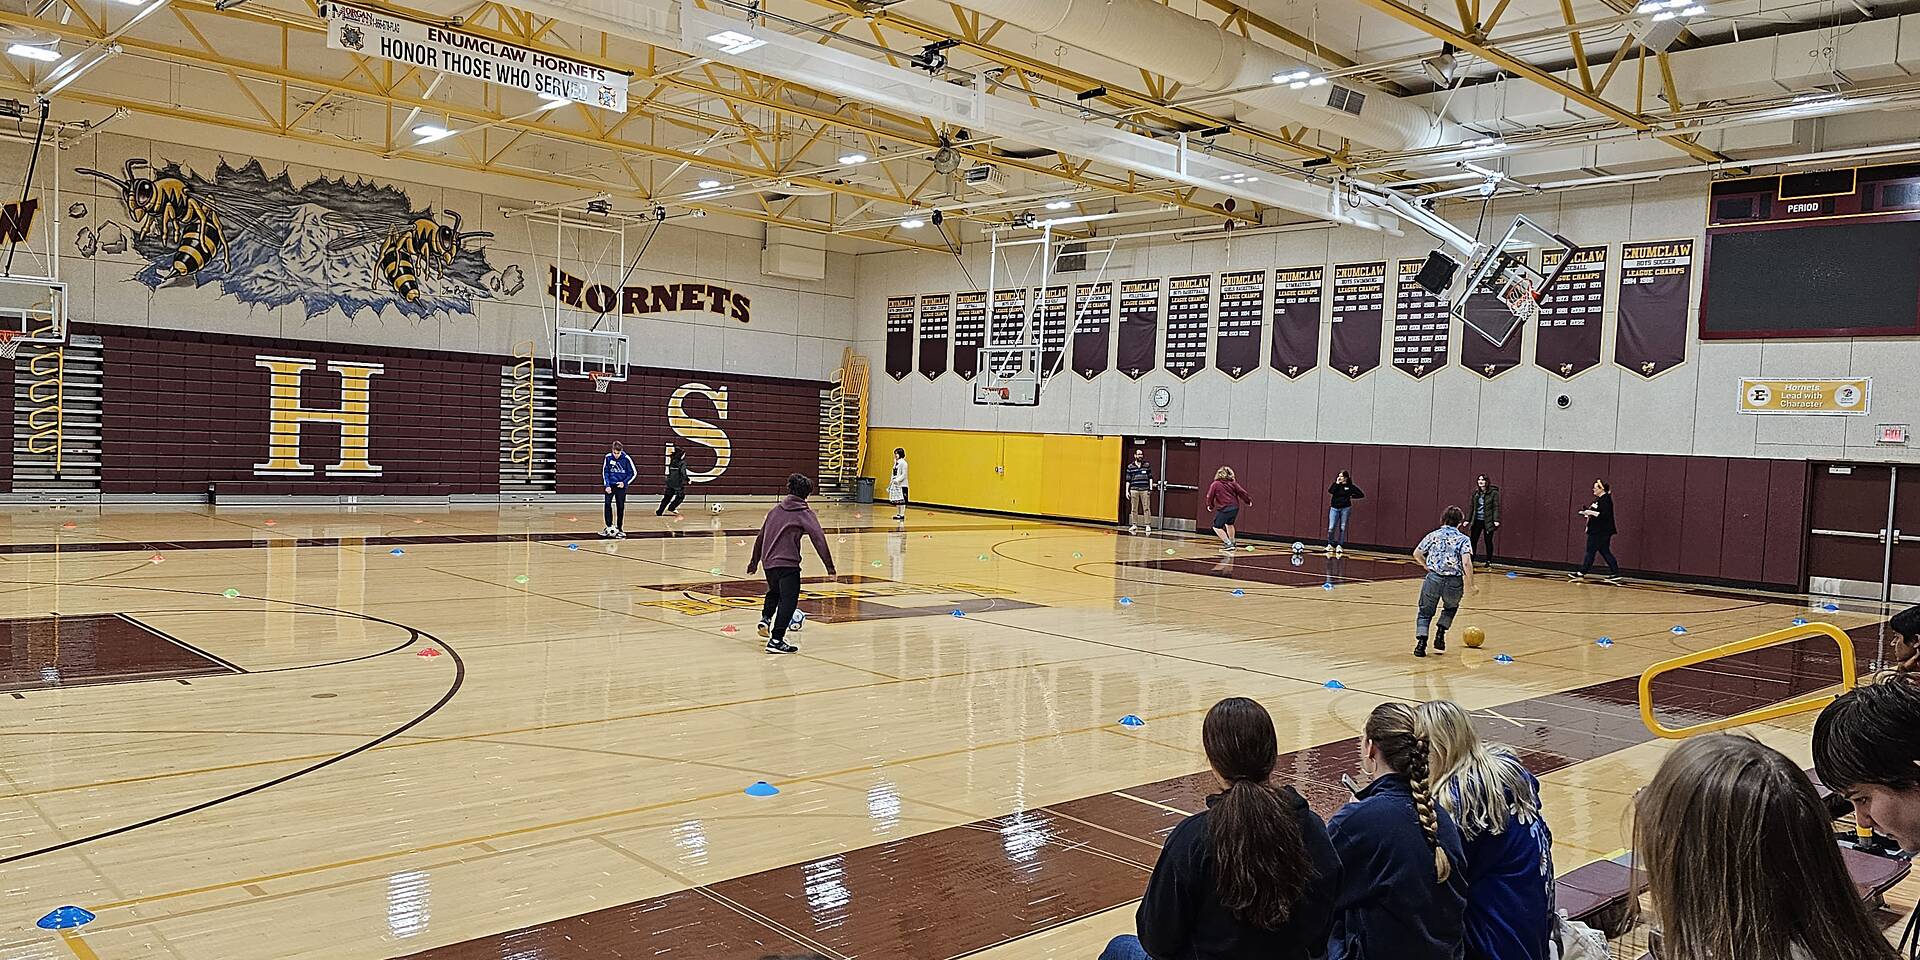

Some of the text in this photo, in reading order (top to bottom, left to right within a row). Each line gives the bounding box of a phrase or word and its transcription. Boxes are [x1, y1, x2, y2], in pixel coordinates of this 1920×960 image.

[428, 28, 605, 81] ENUMCLAW HORNETS
[381, 36, 438, 68] HONOR
[442, 50, 491, 80] THOSE
[496, 63, 530, 88] WHO
[1787, 203, 1819, 213] PERIOD
[1543, 250, 1605, 265] ENCLAW
[1623, 244, 1691, 259] ENUMCLAW
[1276, 270, 1322, 282] ENUMCLAW
[1336, 265, 1384, 278] ENUMCLAW
[1572, 272, 1600, 281] CHAMPS
[1655, 267, 1685, 276] CHAMPS
[1170, 278, 1209, 289] ENUMCLAW
[1221, 274, 1264, 285] ENUMCLAW
[1122, 282, 1159, 292] ENUMCLAW
[549, 264, 751, 323] HORNETS
[1780, 400, 1824, 408] Character
[254, 355, 384, 477] H
[664, 382, 732, 483] S
